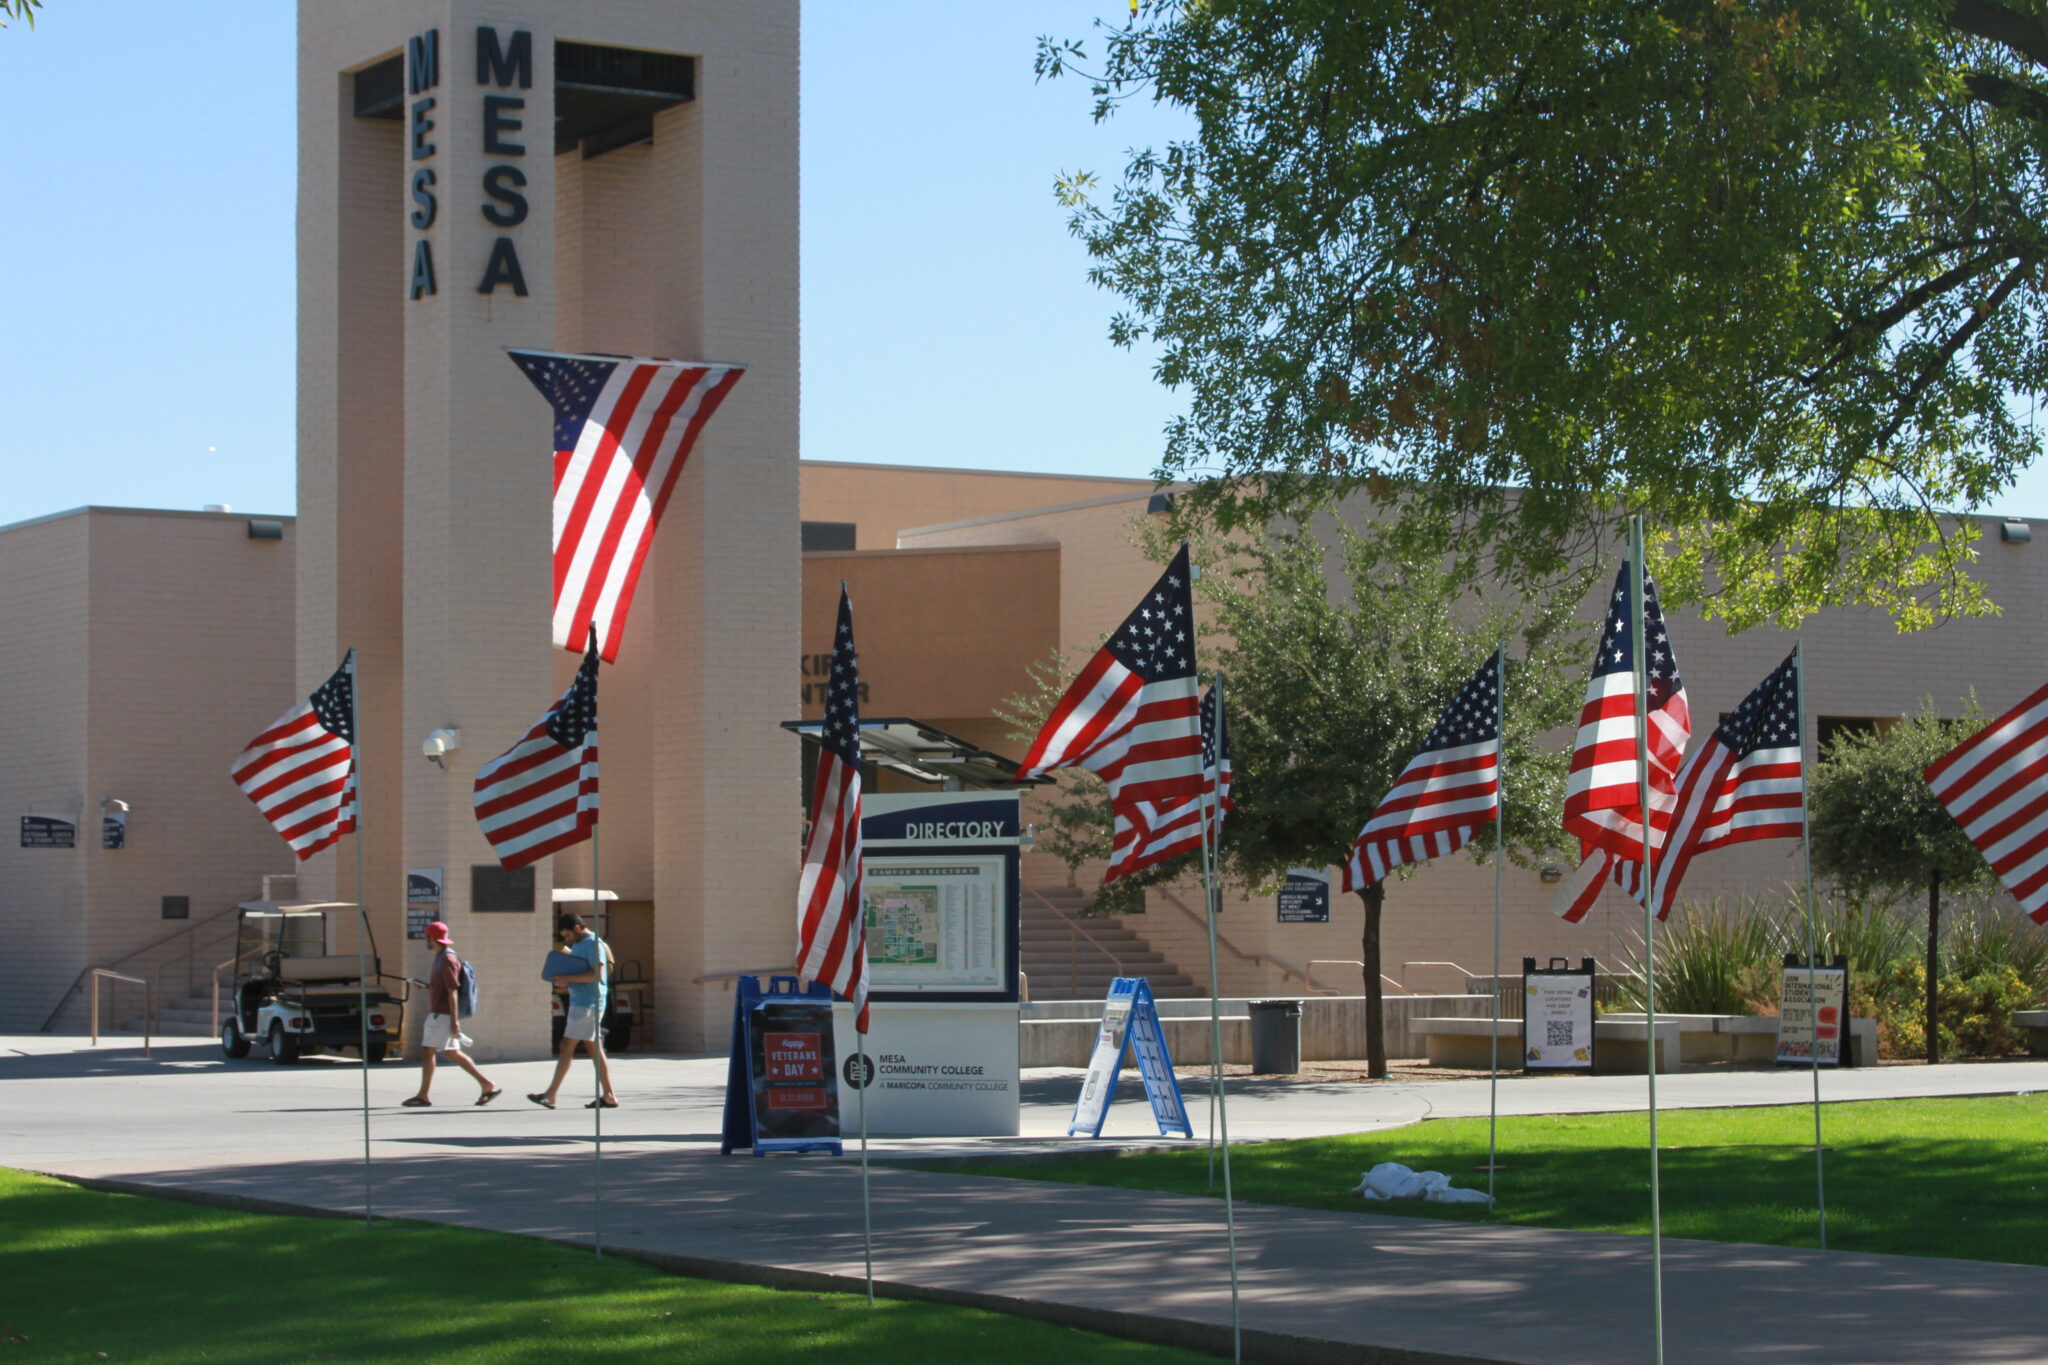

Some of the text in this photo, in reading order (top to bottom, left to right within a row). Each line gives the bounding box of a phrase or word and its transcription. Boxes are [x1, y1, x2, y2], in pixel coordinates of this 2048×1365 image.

[408, 28, 440, 301] MESA
[475, 26, 532, 298] MESA
[905, 821, 1004, 840] DIRECTORY
[771, 1051, 817, 1061] VETERANS
[879, 1054, 906, 1064] MESA
[784, 1064, 804, 1076] DAY
[879, 1065, 984, 1075] COMMUNITY COLLEGE
[886, 1082, 926, 1090] MARICOPA
[927, 1082, 973, 1091] COMMUNITY
[975, 1083, 1009, 1091] COLLEGE
